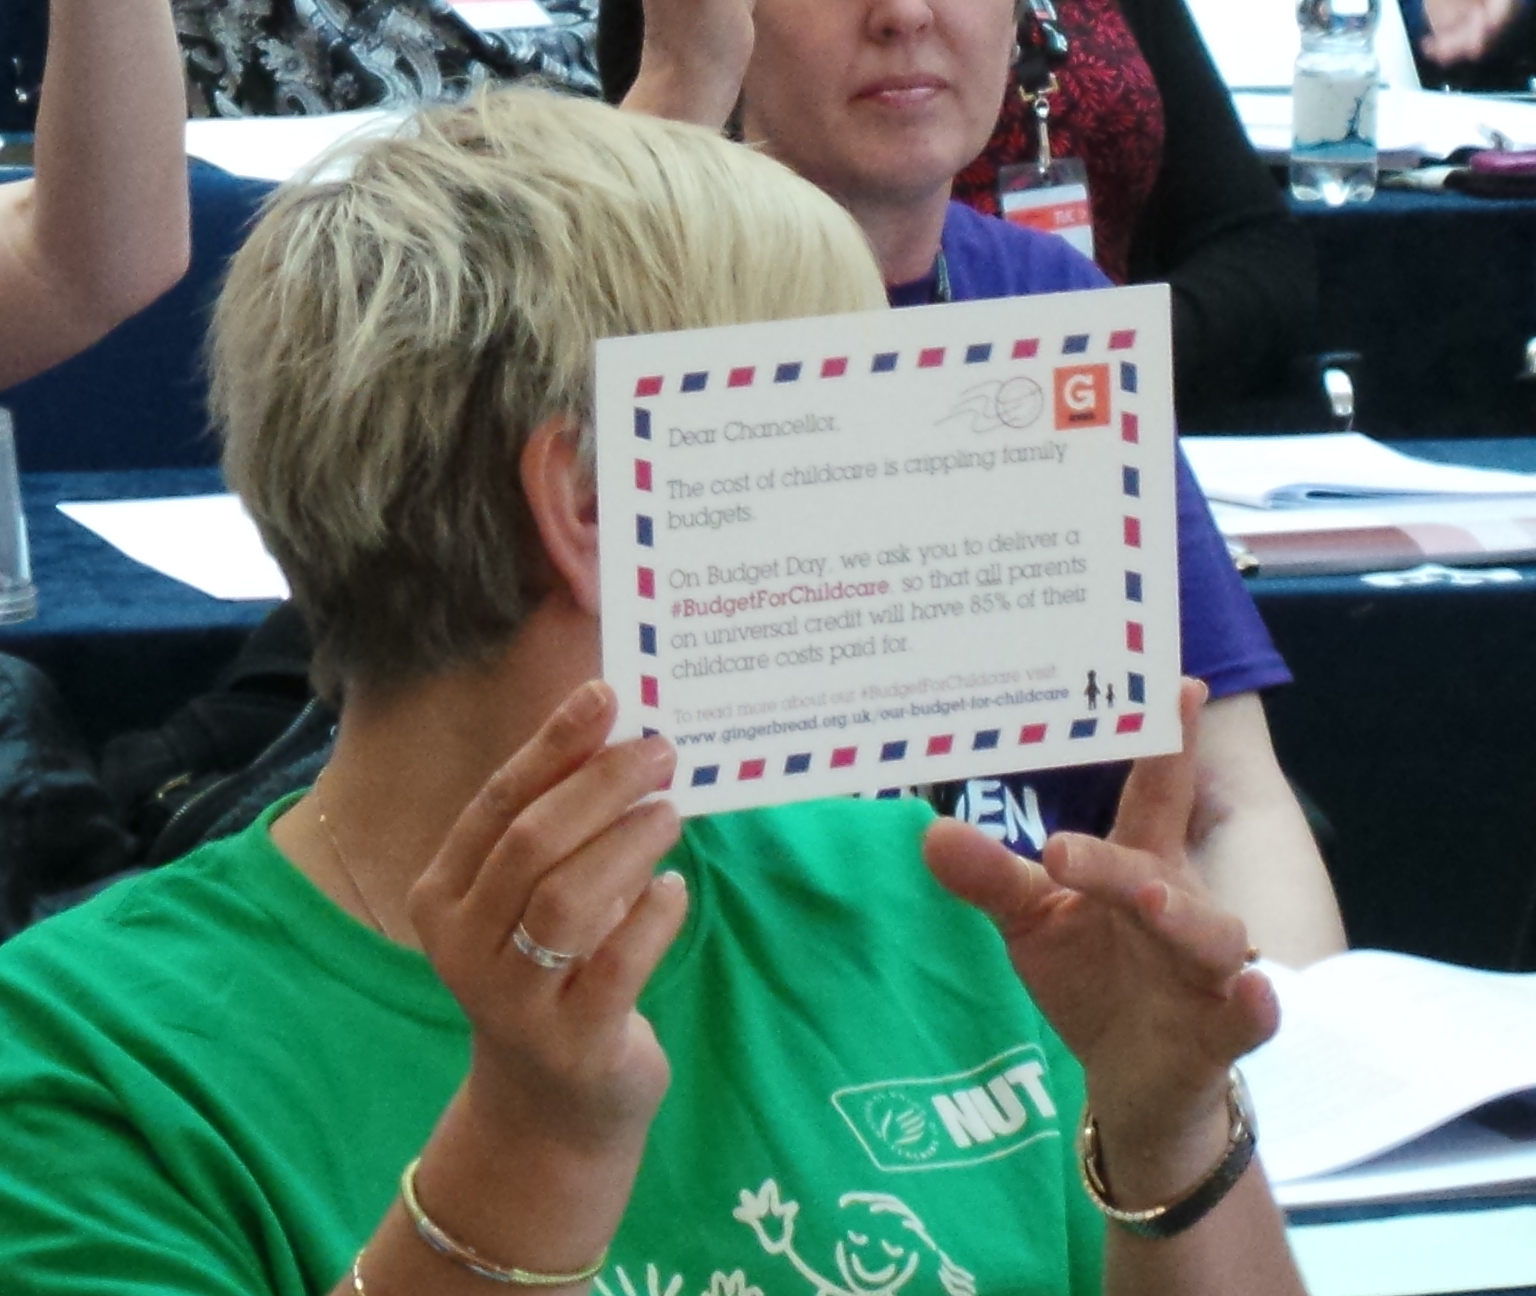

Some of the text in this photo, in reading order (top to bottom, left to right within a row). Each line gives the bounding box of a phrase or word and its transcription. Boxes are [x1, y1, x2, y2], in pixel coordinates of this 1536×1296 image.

[1063, 372, 1095, 412] G
[668, 427, 716, 448] Dear
[666, 441, 1068, 499] The cost of childcare is crippling family
[668, 568, 700, 589] On
[707, 559, 779, 585] Budget
[840, 552, 872, 569] we
[876, 544, 913, 565] ask
[917, 543, 959, 565] you
[963, 538, 984, 556] to
[988, 531, 1059, 552] deliver
[1064, 528, 1081, 545] a
[901, 576, 925, 592] so
[928, 568, 971, 589] that
[976, 564, 1003, 586] all
[1008, 556, 1088, 584] parents
[669, 587, 1086, 649] on universal credit will have 85% of their
[670, 654, 769, 679] childcare
[774, 645, 824, 667] costs
[828, 637, 876, 665] paid
[931, 1061, 1057, 1148] NUT
